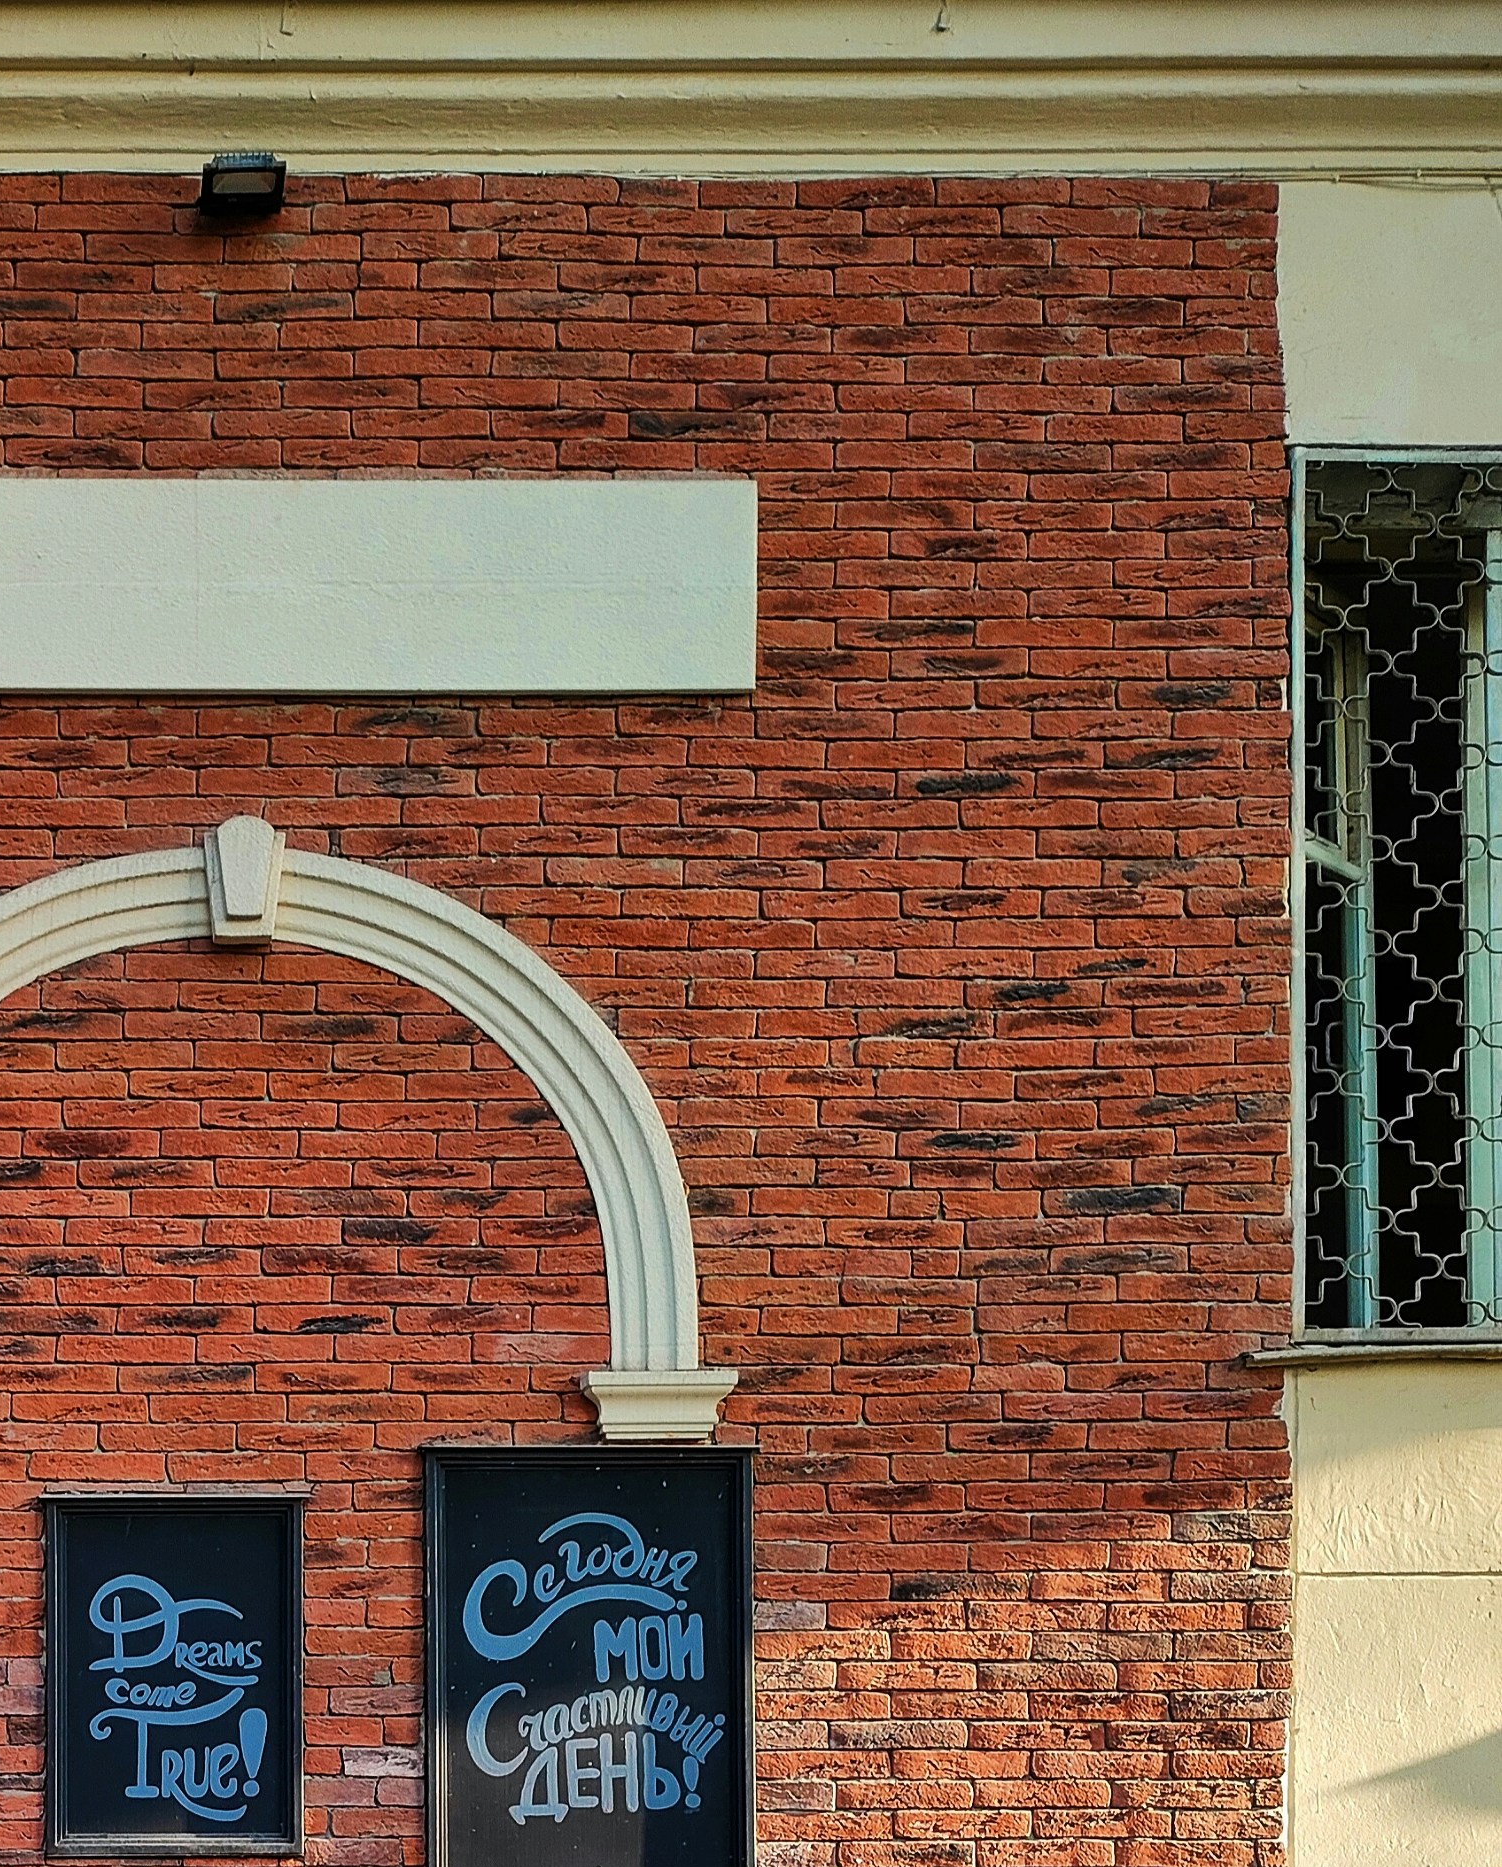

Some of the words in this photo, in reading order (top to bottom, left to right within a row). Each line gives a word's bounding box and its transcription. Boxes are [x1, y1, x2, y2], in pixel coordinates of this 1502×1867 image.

[462, 1512, 699, 1662] Сегодня
[466, 1682, 725, 1777] Счастливый
[508, 1732, 701, 1826] ДЕНЬ!
